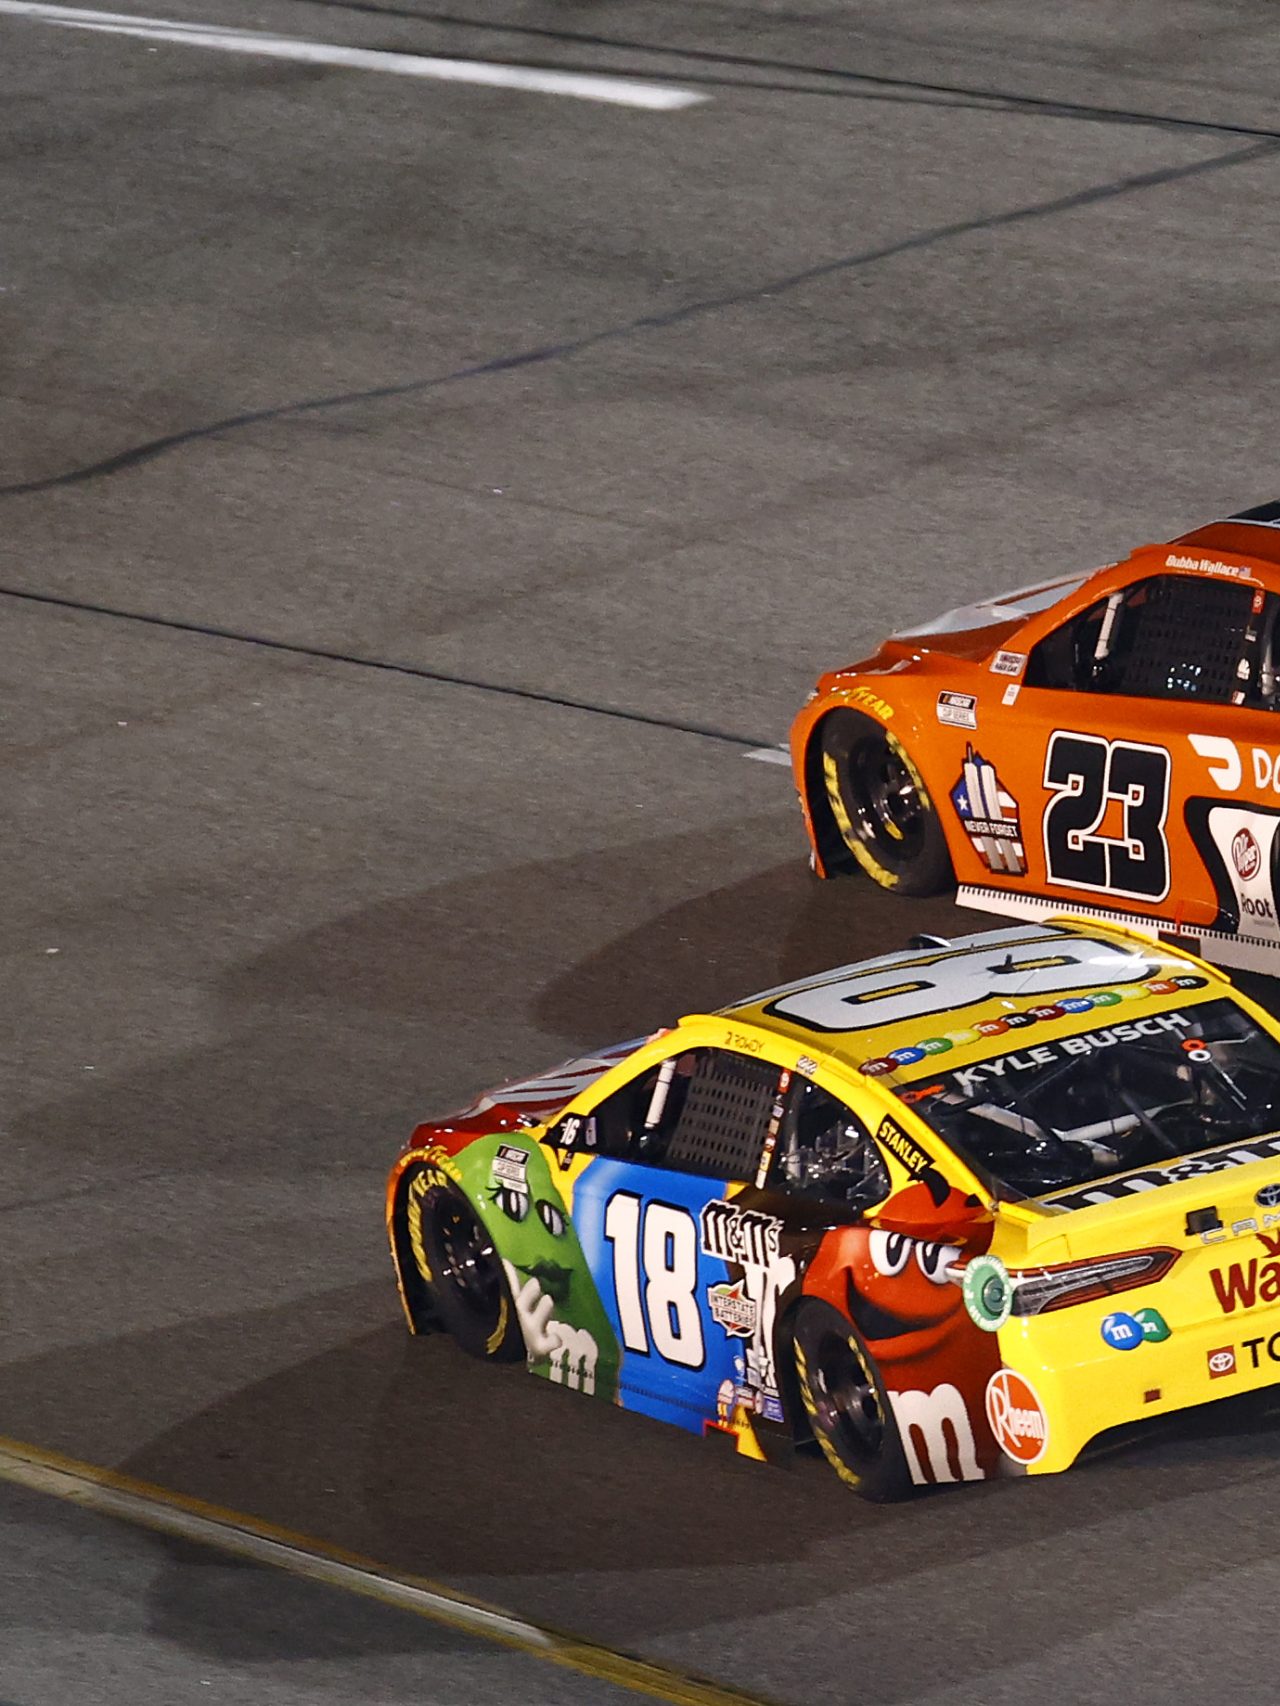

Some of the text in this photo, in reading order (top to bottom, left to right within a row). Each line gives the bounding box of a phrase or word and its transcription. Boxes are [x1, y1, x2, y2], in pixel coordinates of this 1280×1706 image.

[1165, 554, 1240, 577] Bubba Wallace
[1043, 728, 1171, 903] 23
[952, 1012, 1193, 1087] KYLE BUSCH
[879, 1121, 930, 1174] STANLEY
[604, 1188, 705, 1368] 18
[711, 1294, 754, 1314] INTERSTATE
[714, 1306, 754, 1327] BATTERIES
[1110, 1324, 1133, 1340] m
[886, 1383, 986, 1486] m
[991, 1374, 1045, 1447] Rheem
